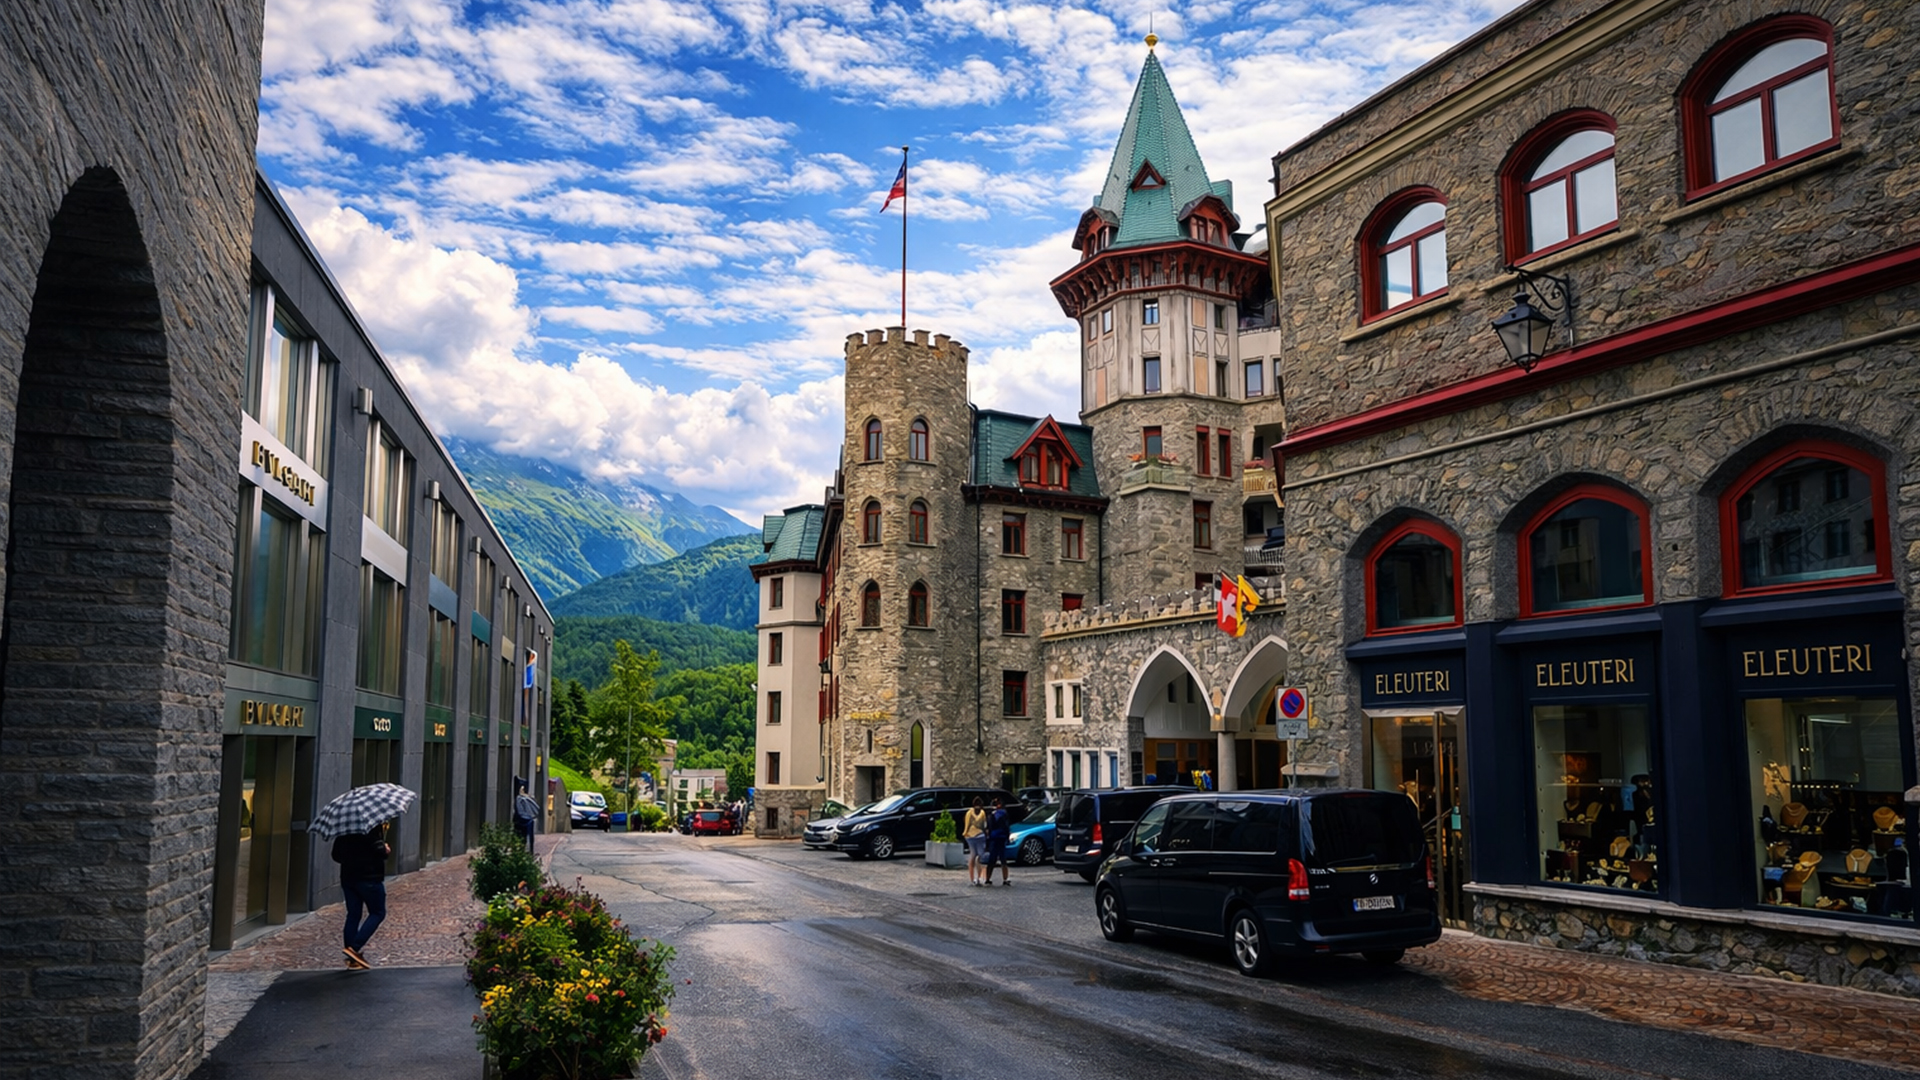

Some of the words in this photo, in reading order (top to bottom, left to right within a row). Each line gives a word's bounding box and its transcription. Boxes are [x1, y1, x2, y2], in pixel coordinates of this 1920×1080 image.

[1536, 658, 1635, 687] ELEUTERI
[1743, 644, 1872, 677] ELEUTERI
[1375, 670, 1449, 695] ELEUTERI
